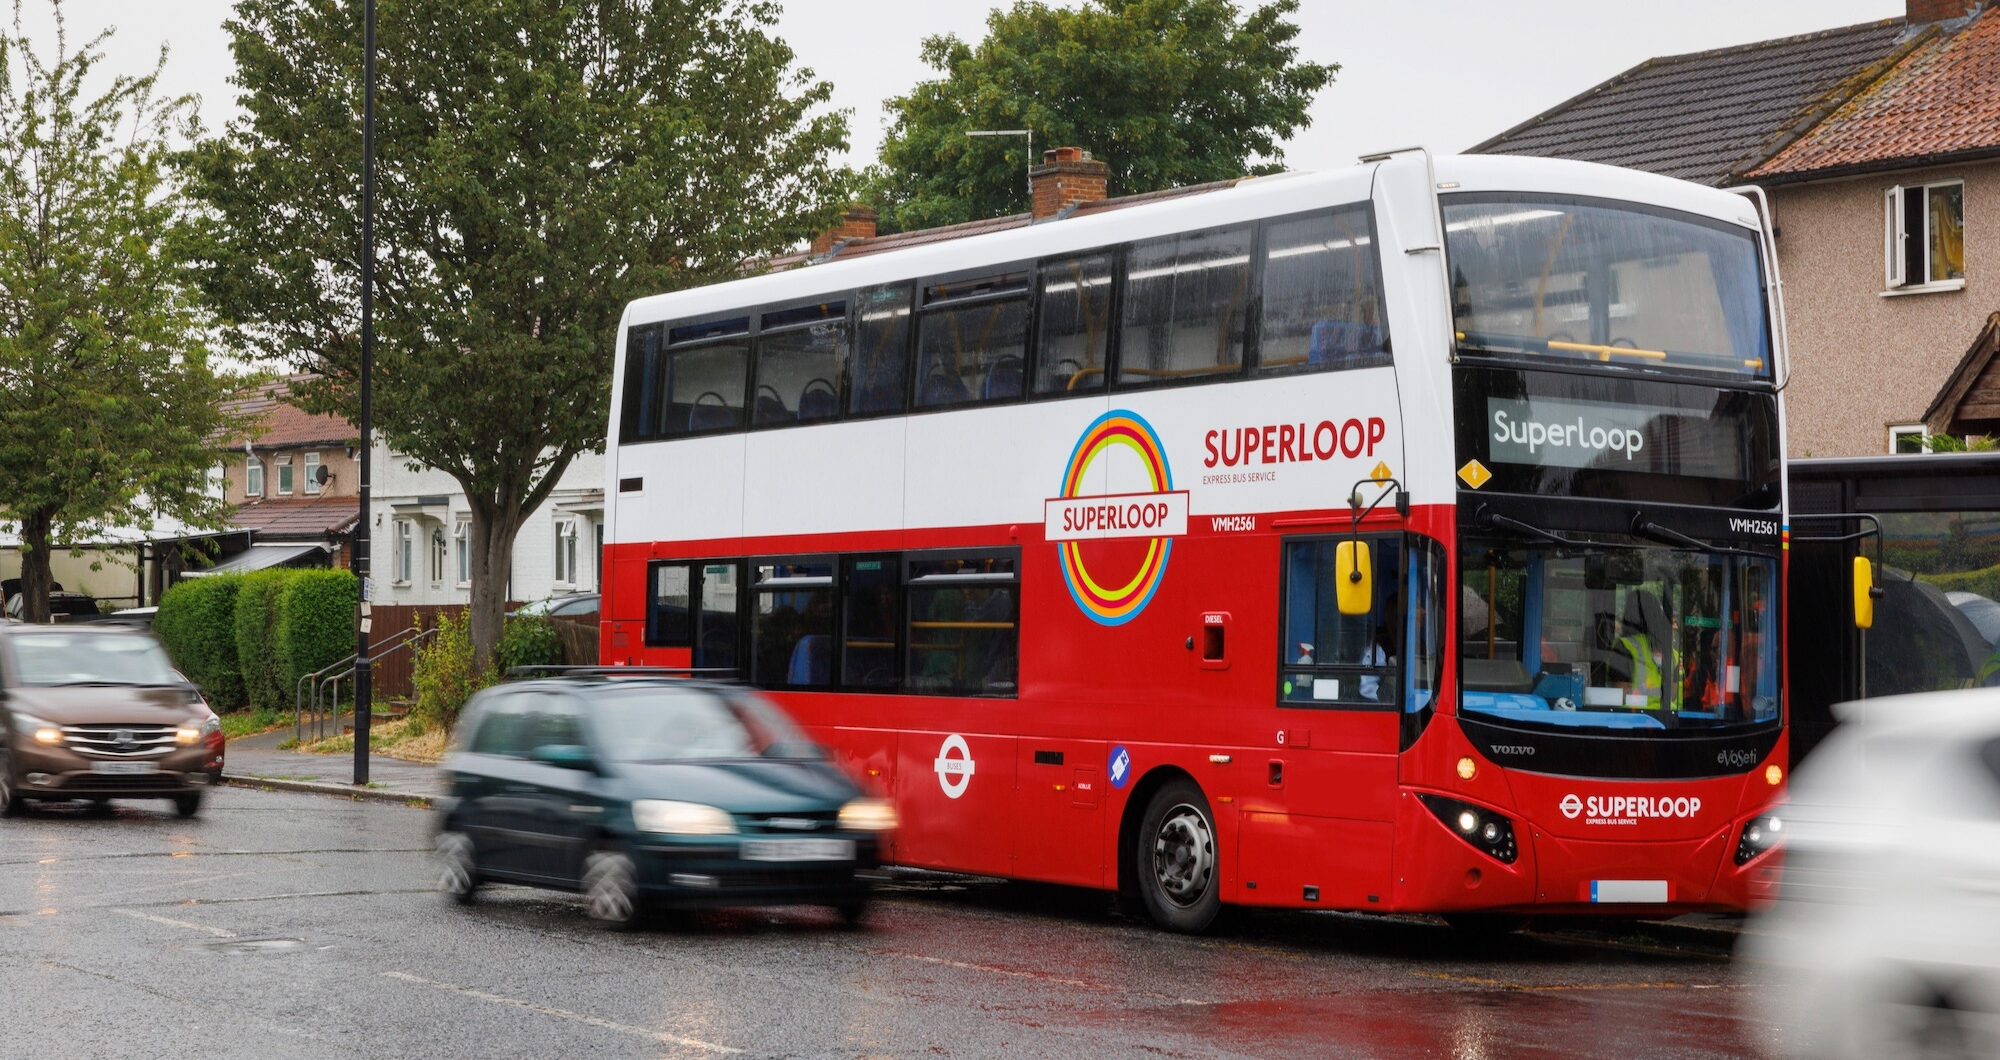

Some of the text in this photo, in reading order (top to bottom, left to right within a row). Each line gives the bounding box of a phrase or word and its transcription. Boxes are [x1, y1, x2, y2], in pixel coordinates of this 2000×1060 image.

[1204, 417, 1385, 468] SUPERLOOP
[1494, 410, 1643, 460] Superloop
[1203, 472, 1275, 484] EXPRESS BUS SERVICE
[1063, 503, 1168, 532] SUPERLOOP
[1212, 516, 1255, 532] VMH2561
[1729, 518, 1777, 535] VMH2561
[1205, 615, 1223, 623] DIESEL
[1277, 730, 1284, 744] G
[1490, 745, 1535, 755] VOLVO
[947, 762, 961, 770] BUSES
[1586, 796, 1701, 818] SUPERLOOP
